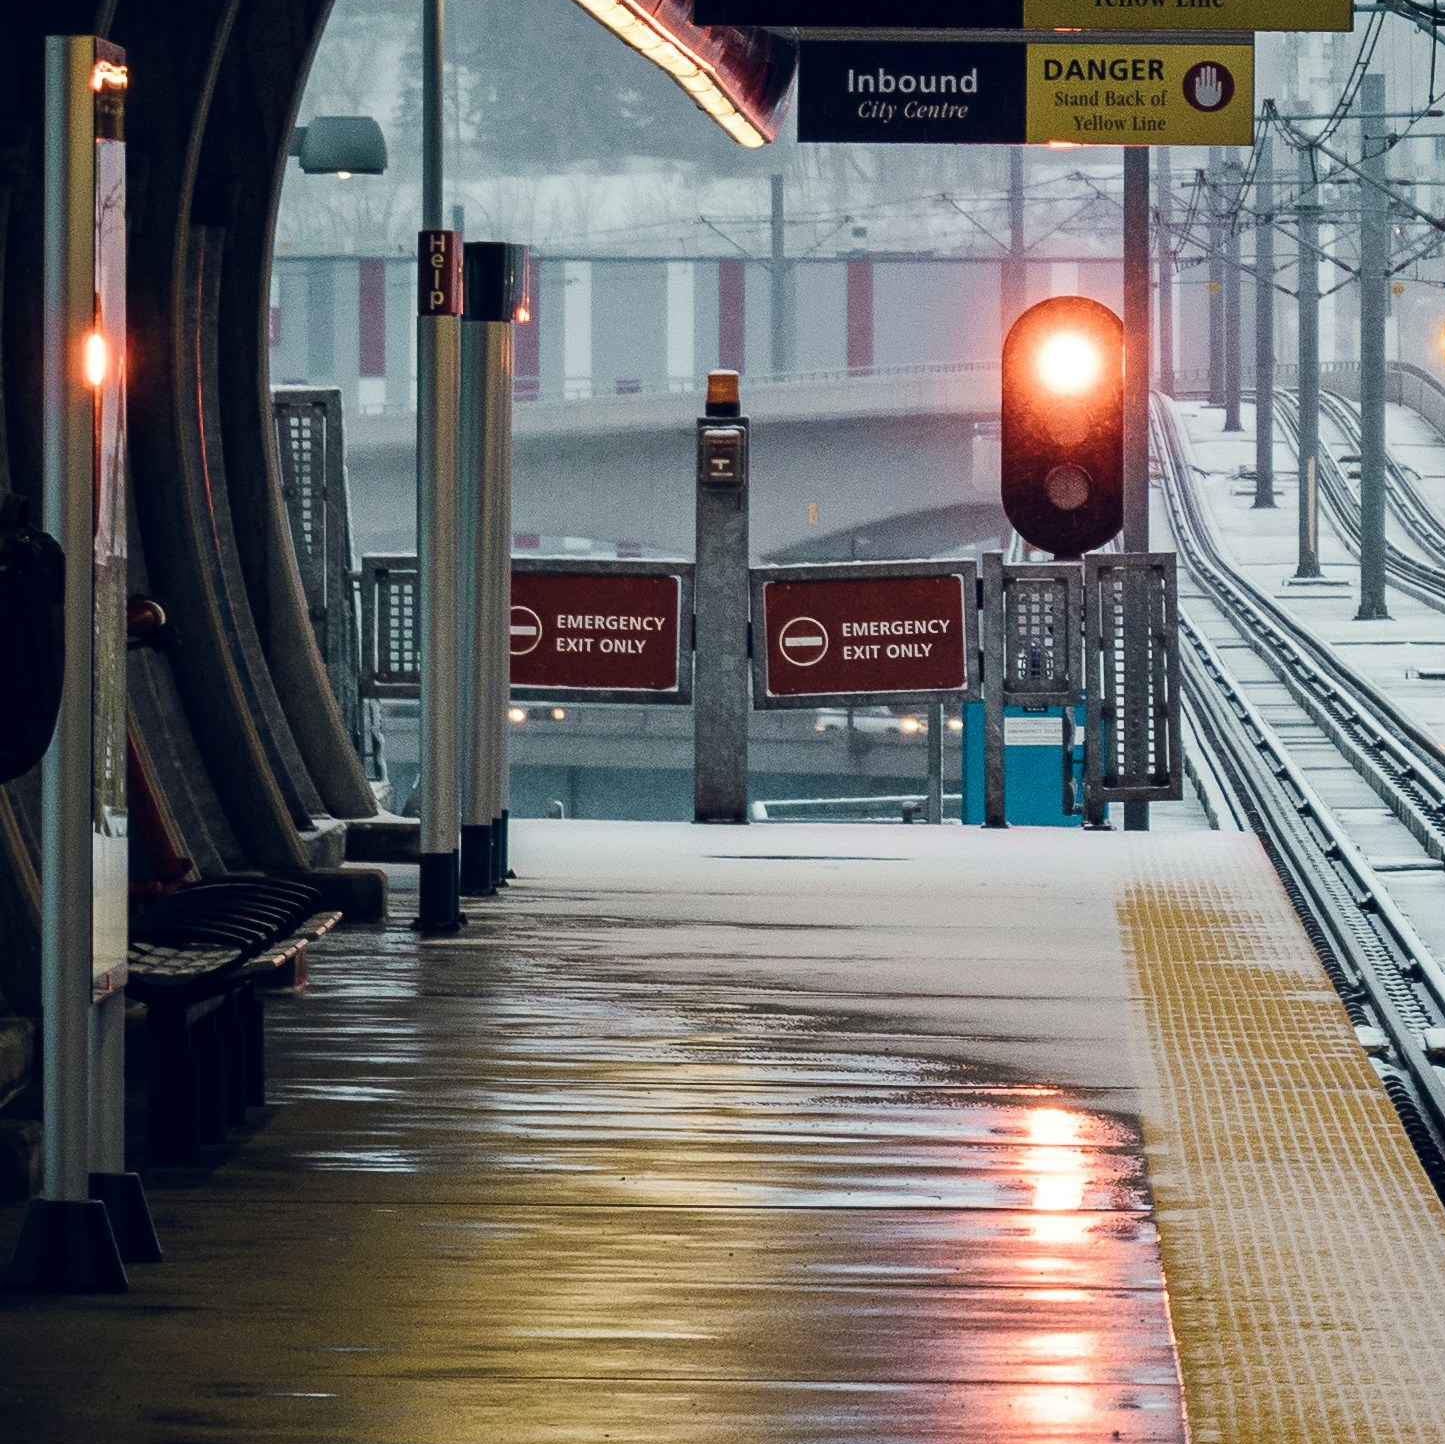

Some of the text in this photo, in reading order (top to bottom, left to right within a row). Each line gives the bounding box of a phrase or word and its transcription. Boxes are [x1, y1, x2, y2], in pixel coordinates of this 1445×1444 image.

[1043, 58, 1165, 82] DANGER
[847, 67, 978, 94] Inbound
[1054, 89, 1168, 107] Stand Back of
[857, 100, 969, 123] City Centre
[1073, 114, 1167, 132] Yellow Line
[429, 233, 446, 310] Help
[556, 614, 666, 631] EMERGENCY
[841, 619, 950, 638] EMERGENCY
[556, 637, 646, 654] EXIT ONLY
[842, 643, 933, 661] EXIT ONLY
